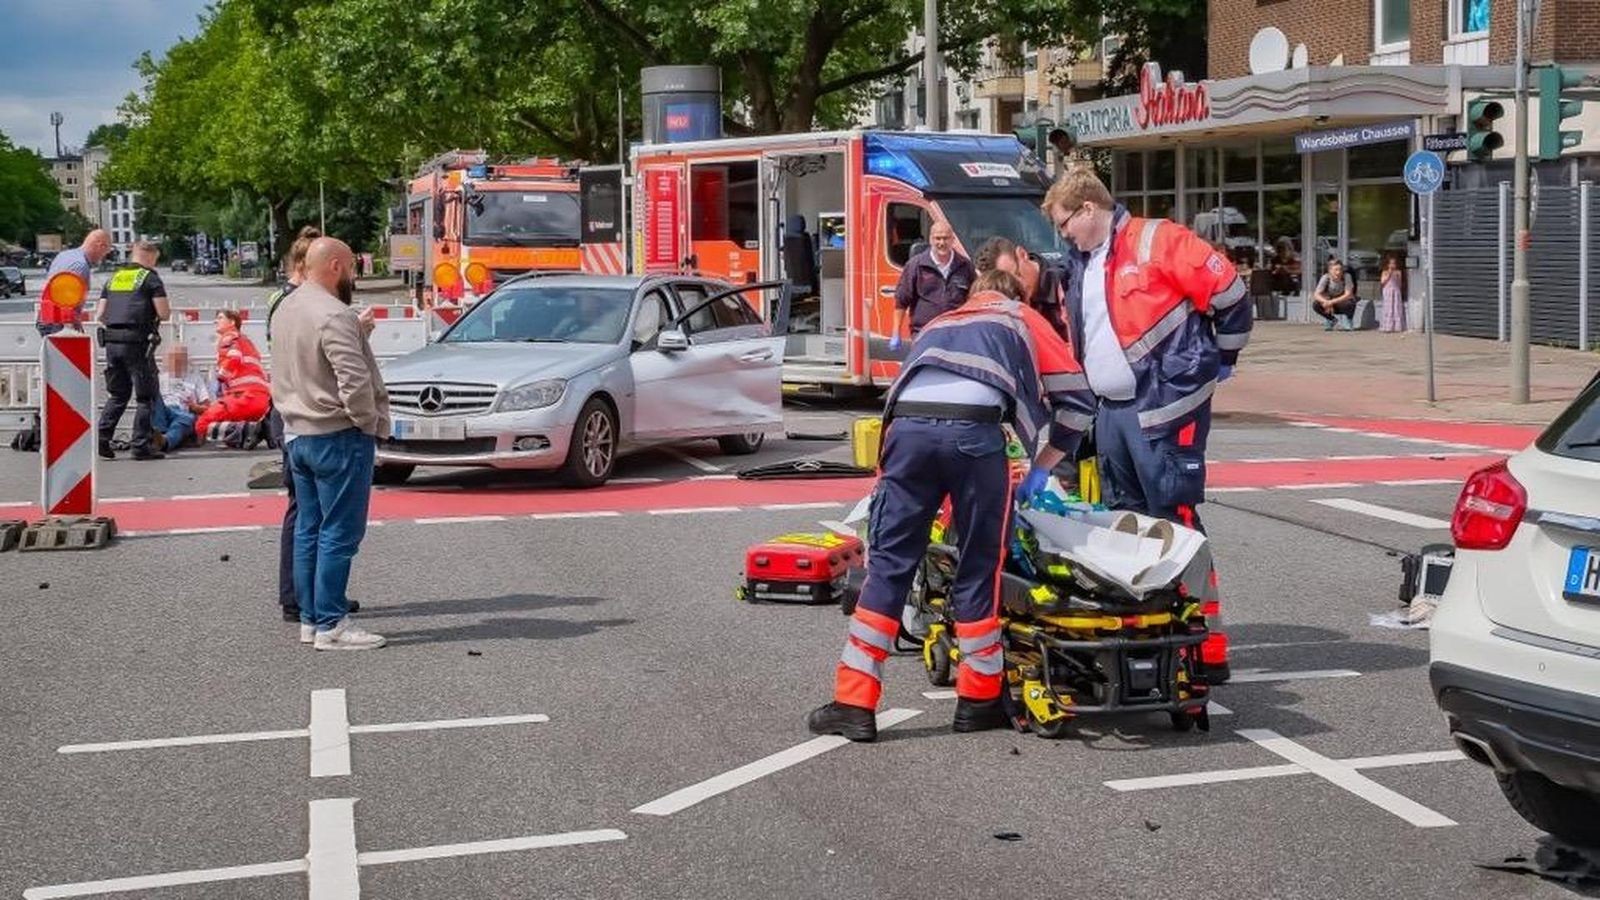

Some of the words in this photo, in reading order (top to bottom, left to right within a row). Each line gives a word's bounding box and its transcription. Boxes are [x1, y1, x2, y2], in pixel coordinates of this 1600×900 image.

[1069, 105, 1133, 136] RATTORIA
[1300, 132, 1358, 149] Wandsbeker
[1361, 125, 1410, 141] Chaussee
